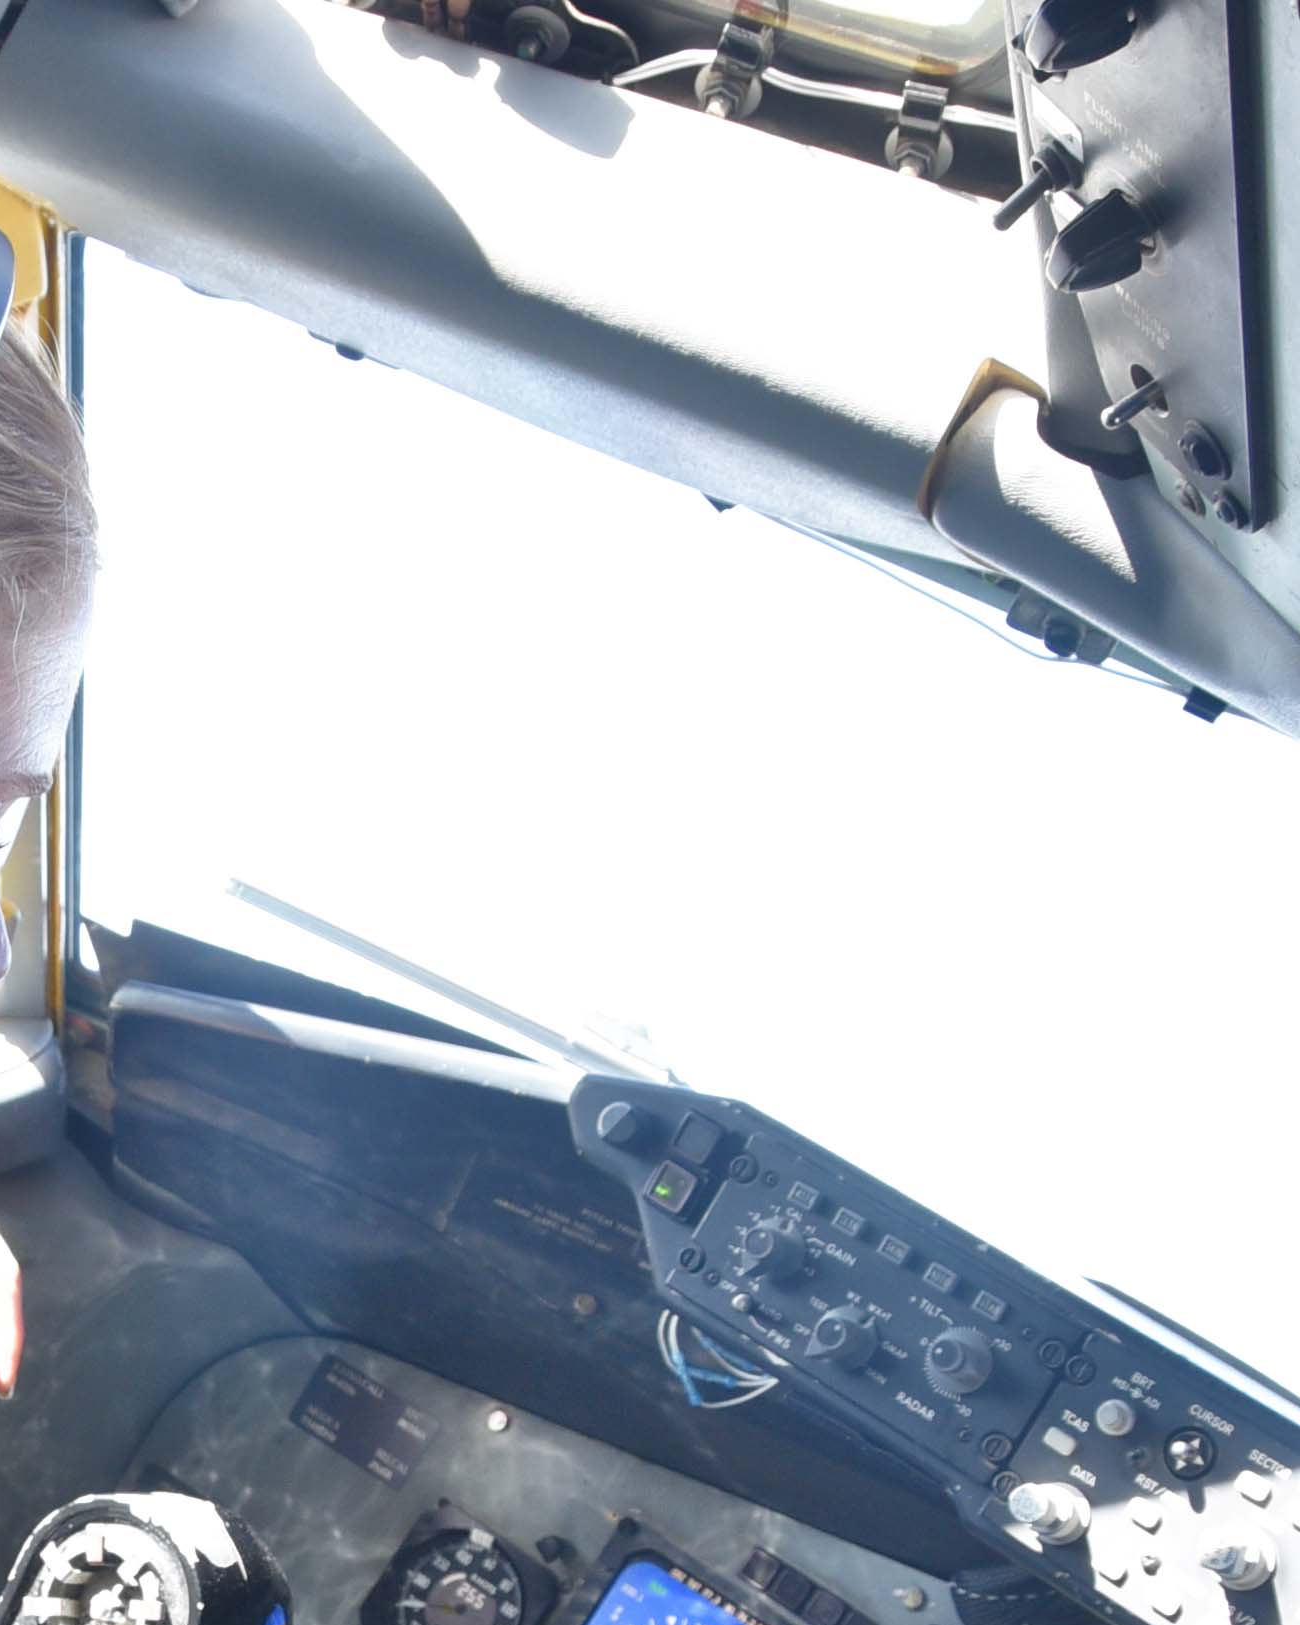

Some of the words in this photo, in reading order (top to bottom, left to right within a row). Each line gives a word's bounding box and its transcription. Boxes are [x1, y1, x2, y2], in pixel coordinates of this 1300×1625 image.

[825, 1243, 859, 1267] GAIN
[920, 1298, 942, 1317] TILT
[1131, 1371, 1156, 1389] BRT
[896, 1391, 936, 1422] RADAR
[1061, 1409, 1090, 1433] TCAS
[1189, 1404, 1235, 1436] CURSOR
[1069, 1464, 1097, 1488] DATA
